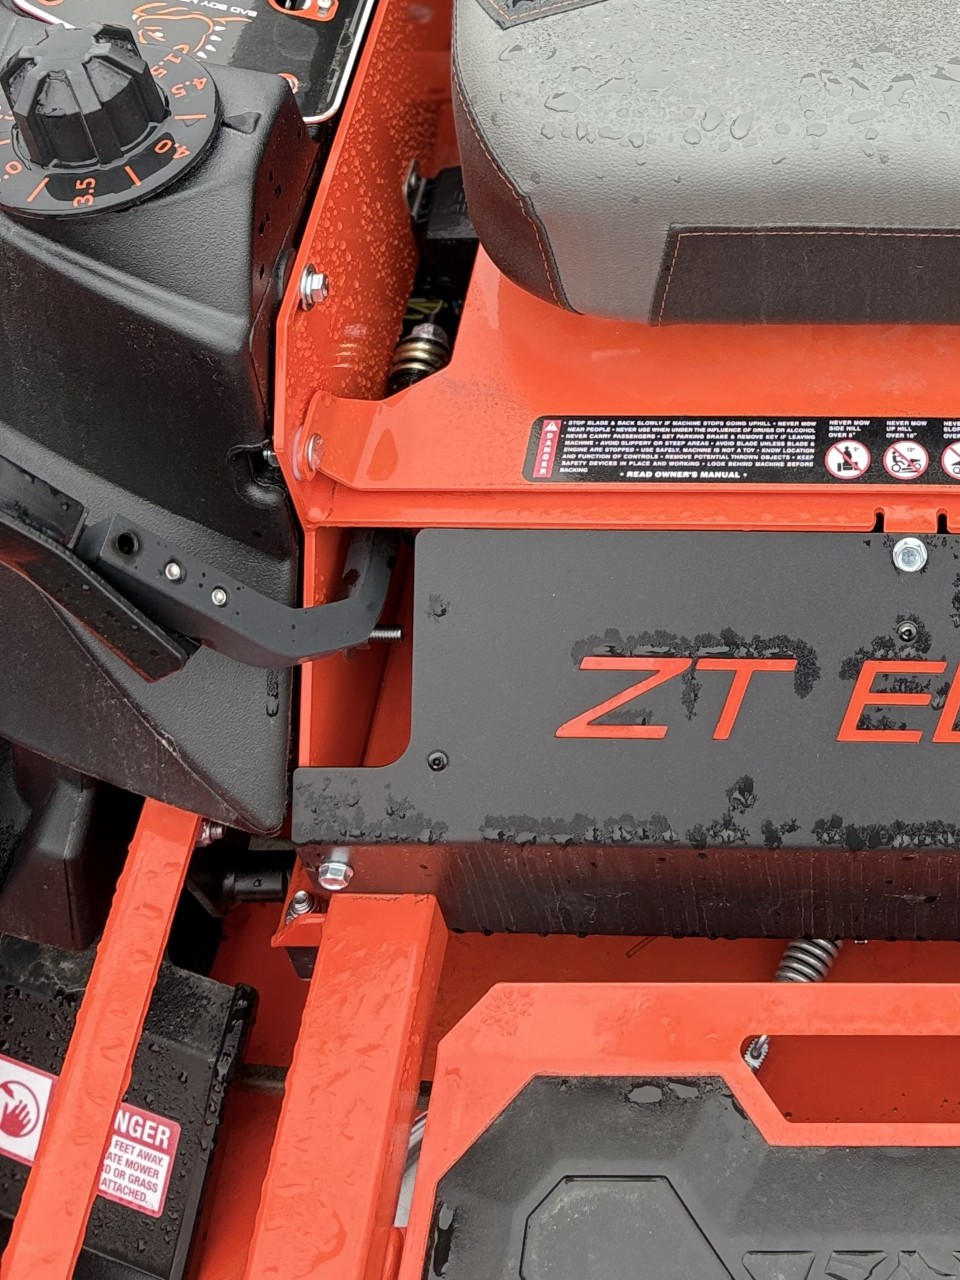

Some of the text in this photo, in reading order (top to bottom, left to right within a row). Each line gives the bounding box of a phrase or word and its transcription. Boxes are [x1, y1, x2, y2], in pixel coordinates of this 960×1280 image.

[200, 0, 228, 11] BOY
[230, 6, 258, 17] BAD
[150, 53, 183, 78] 1.5
[170, 77, 208, 98] 4.5
[153, 139, 191, 160] 4.0
[0, 161, 23, 182] .0
[72, 177, 96, 208] 3.5
[539, 432, 554, 475] DANGER
[554, 656, 799, 740] ZT
[113, 1109, 171, 1150] NGER
[113, 1139, 136, 1156] FEET
[136, 1149, 164, 1167] AWAY.
[113, 1167, 126, 1180] OR
[128, 1173, 158, 1193] GRASS
[124, 1158, 160, 1180] MOWER
[100, 1176, 148, 1204] ATTACHED.
